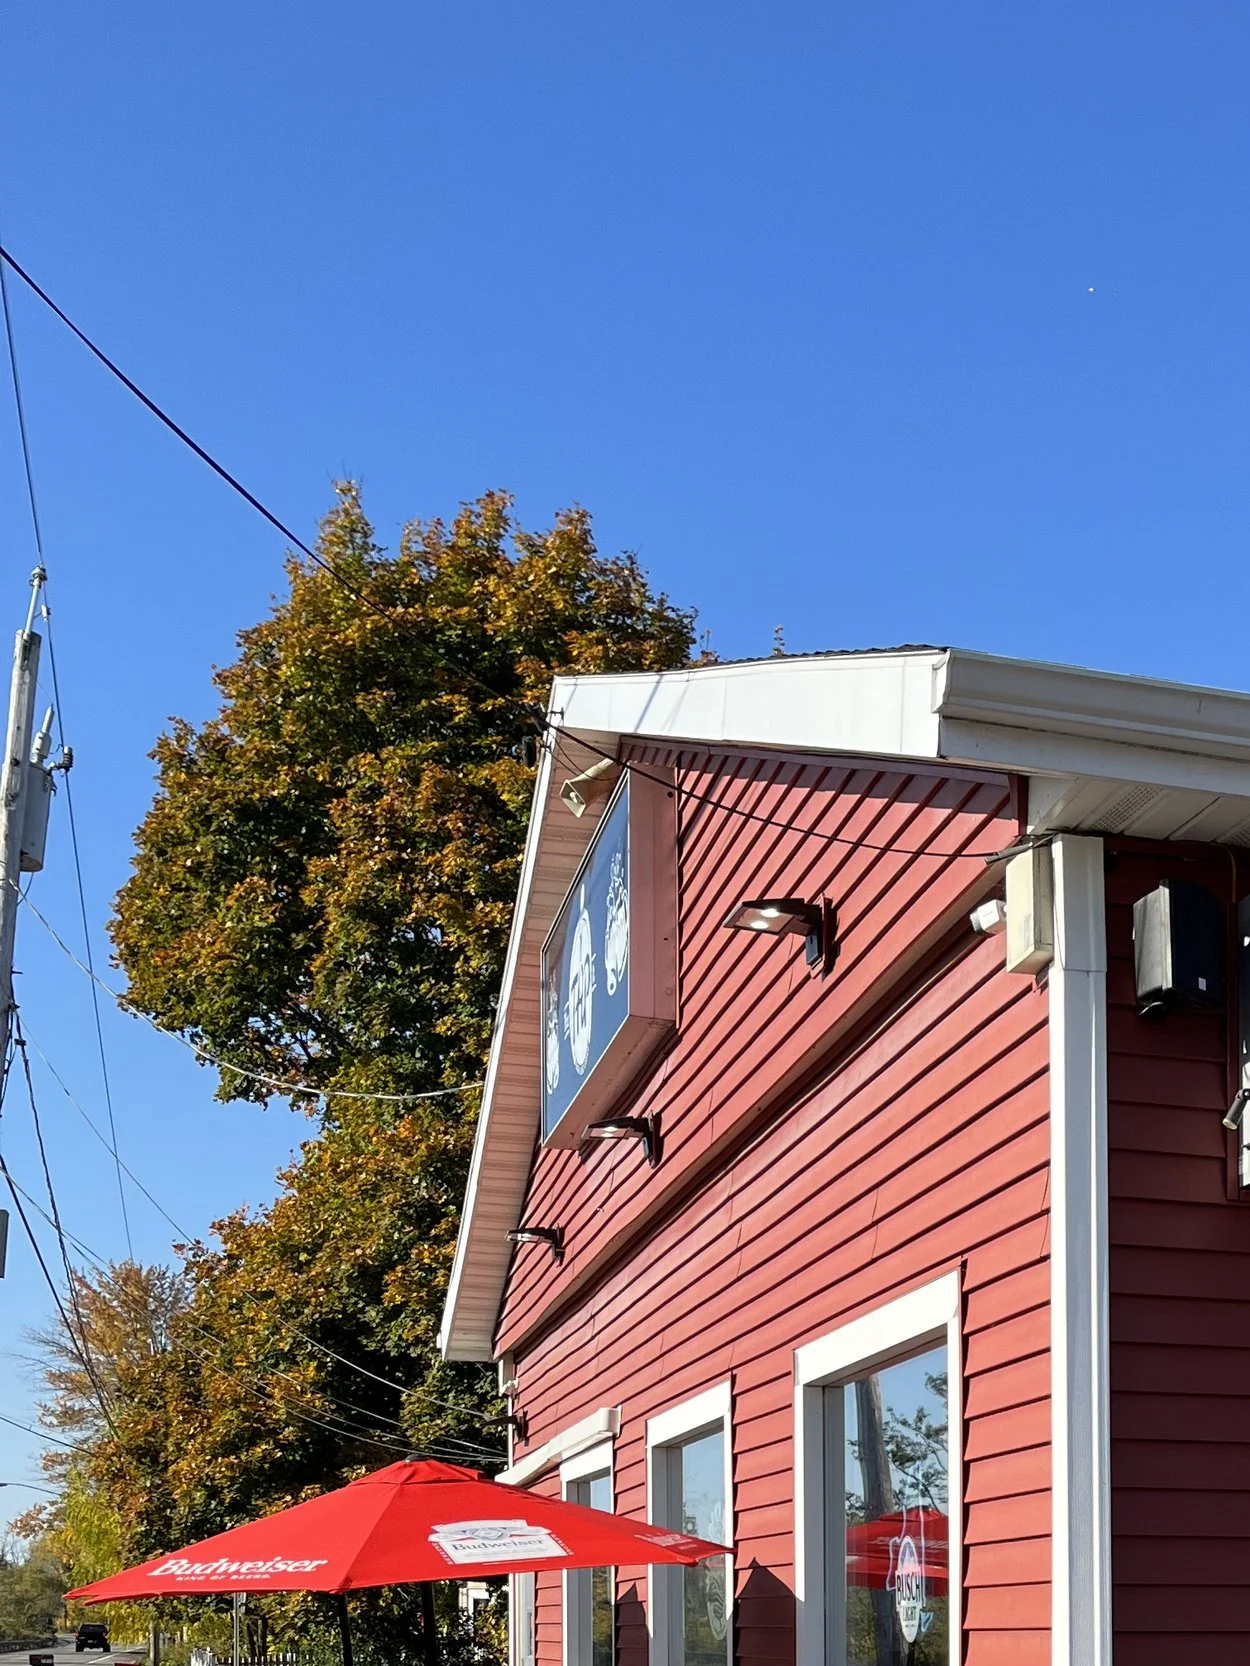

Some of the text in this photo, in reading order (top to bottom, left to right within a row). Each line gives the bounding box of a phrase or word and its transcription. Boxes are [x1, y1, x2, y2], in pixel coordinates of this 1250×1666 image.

[452, 1538, 545, 1551] Budweiser
[147, 1556, 328, 1576] Budweiser
[896, 1571, 921, 1606] BUSCH
